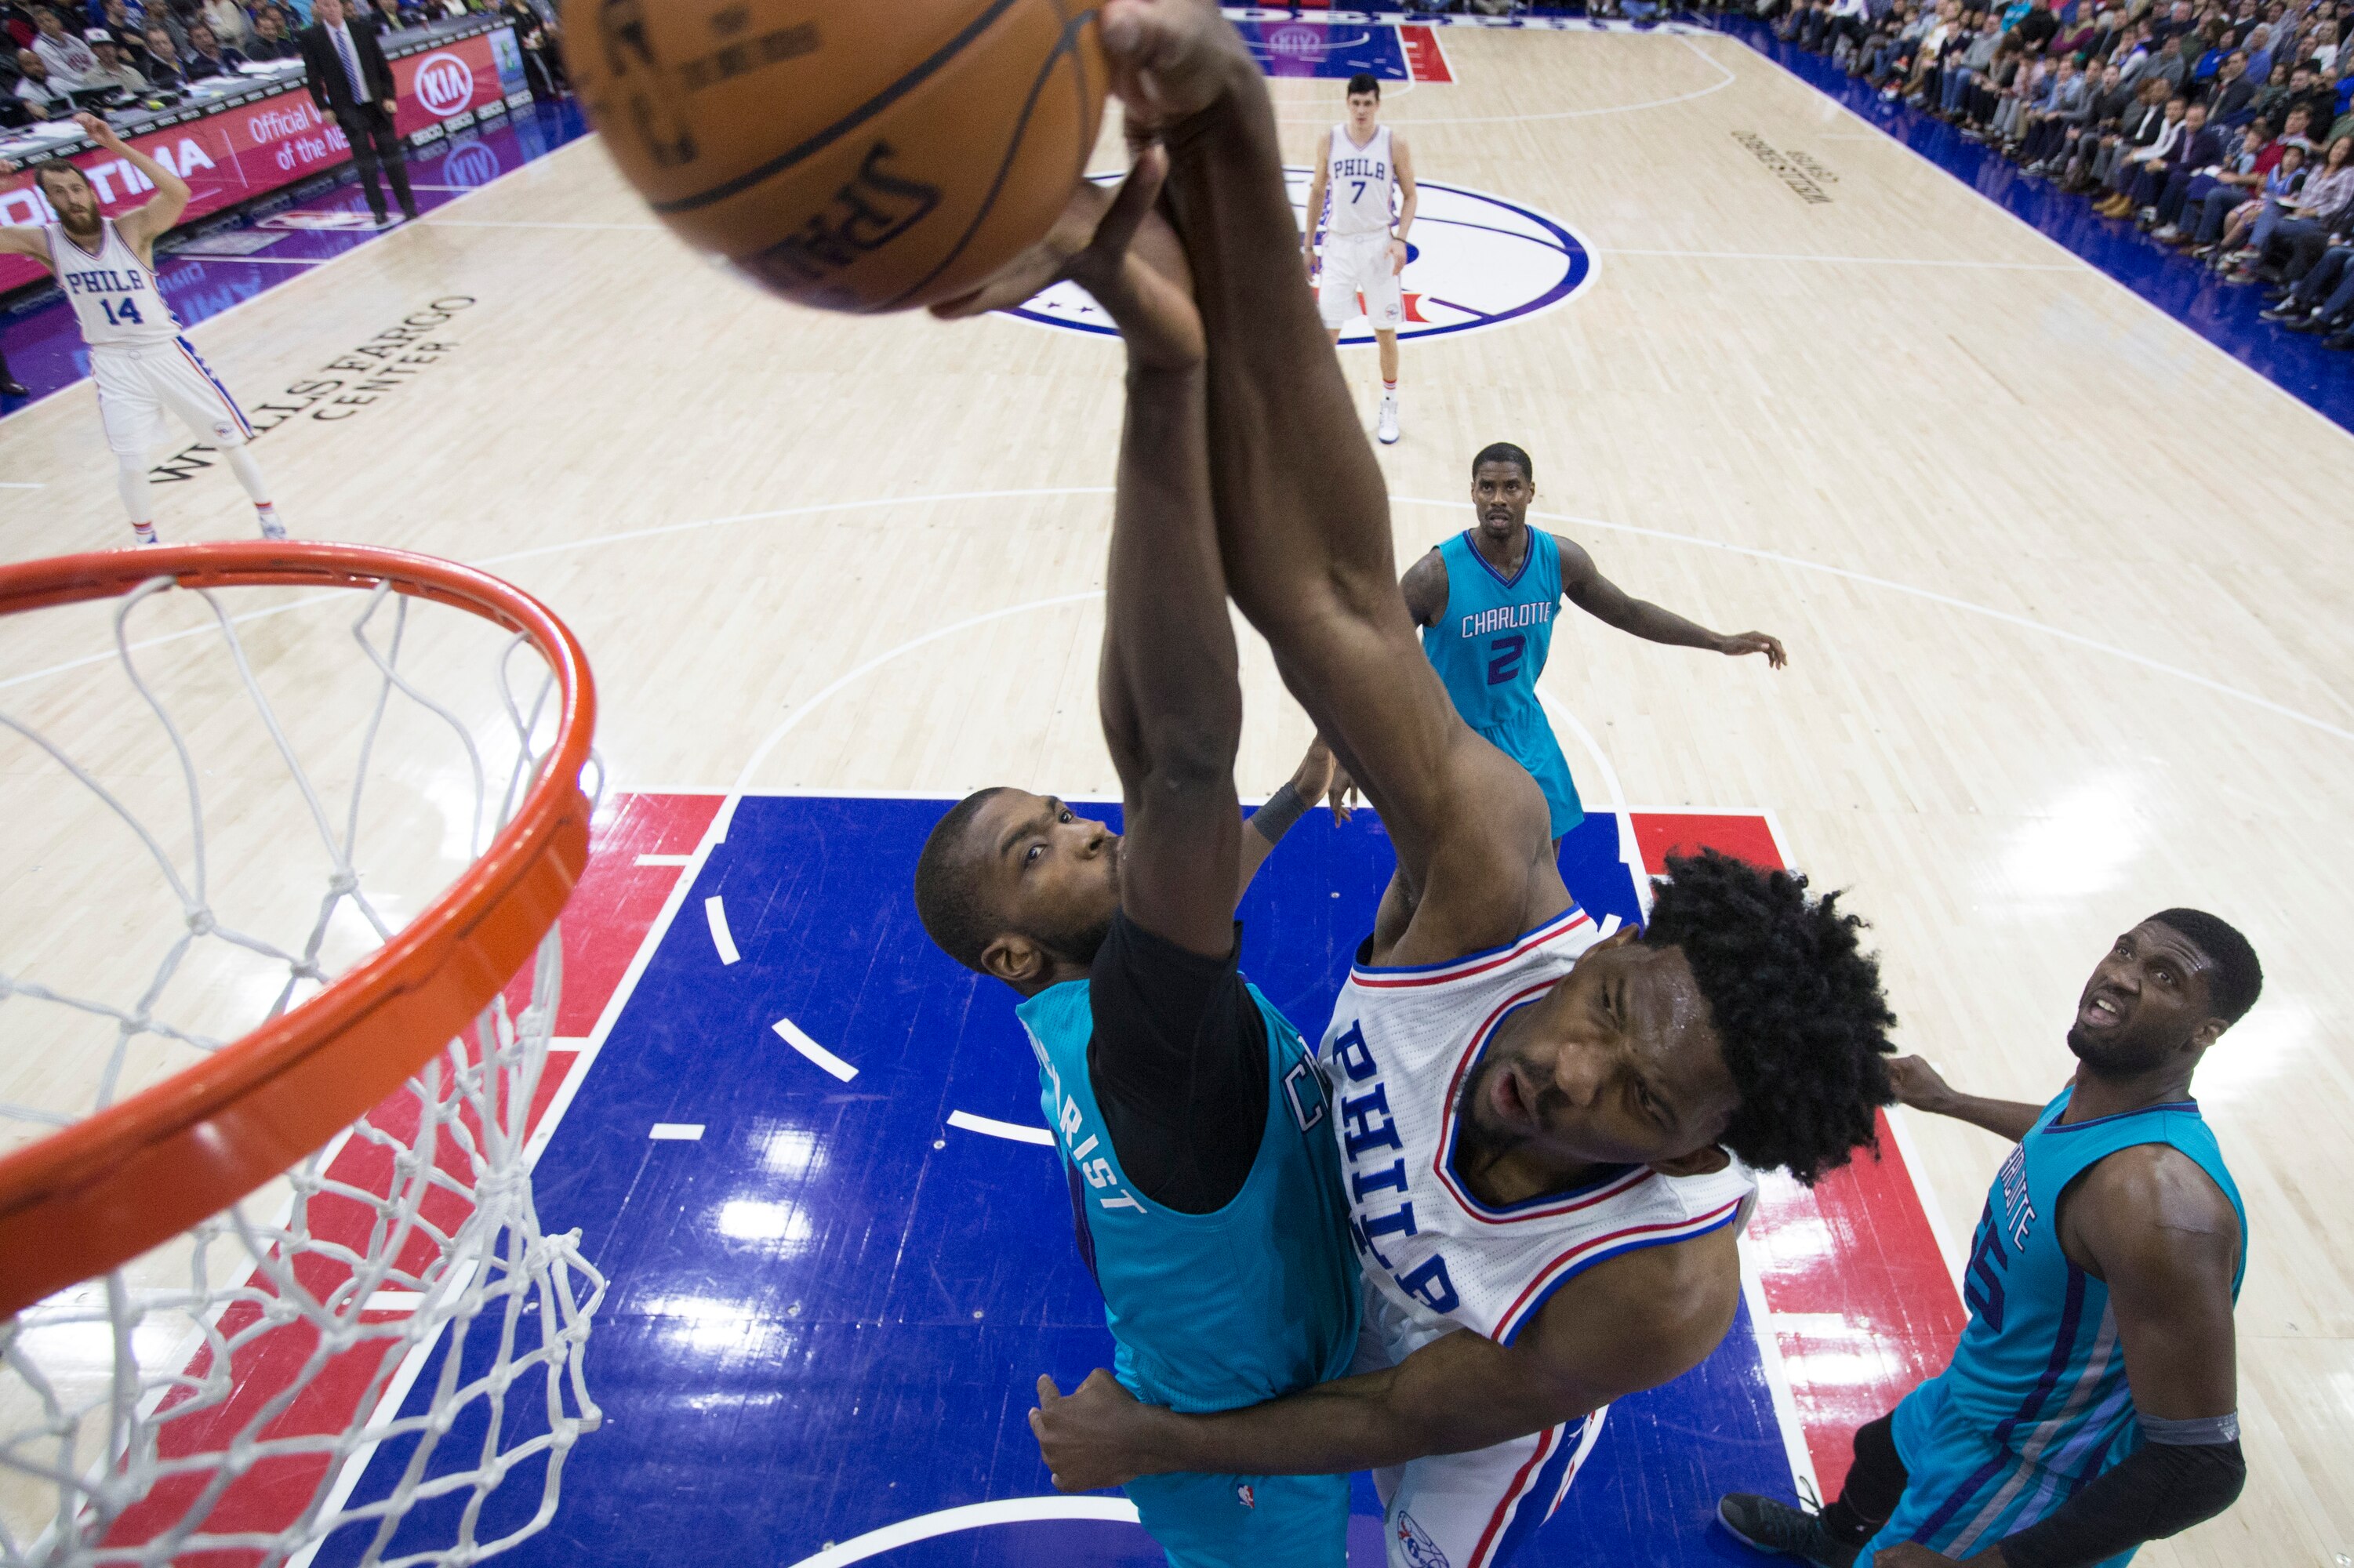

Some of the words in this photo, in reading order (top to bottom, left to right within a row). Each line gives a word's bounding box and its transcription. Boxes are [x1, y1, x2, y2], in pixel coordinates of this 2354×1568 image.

[423, 63, 468, 107] KIA
[248, 103, 311, 144] Official
[276, 140, 296, 170] of
[296, 137, 328, 163] the
[1334, 159, 1385, 180] PHILA
[1351, 181, 1366, 204] 7
[65, 270, 145, 295] PHILA
[100, 297, 144, 325] 14
[320, 295, 476, 373] FARGO
[312, 341, 460, 421] CENTER
[1462, 601, 1552, 638] CHARLOTTE
[1488, 634, 1526, 686] 2
[1334, 1019, 1460, 1315] PHILA
